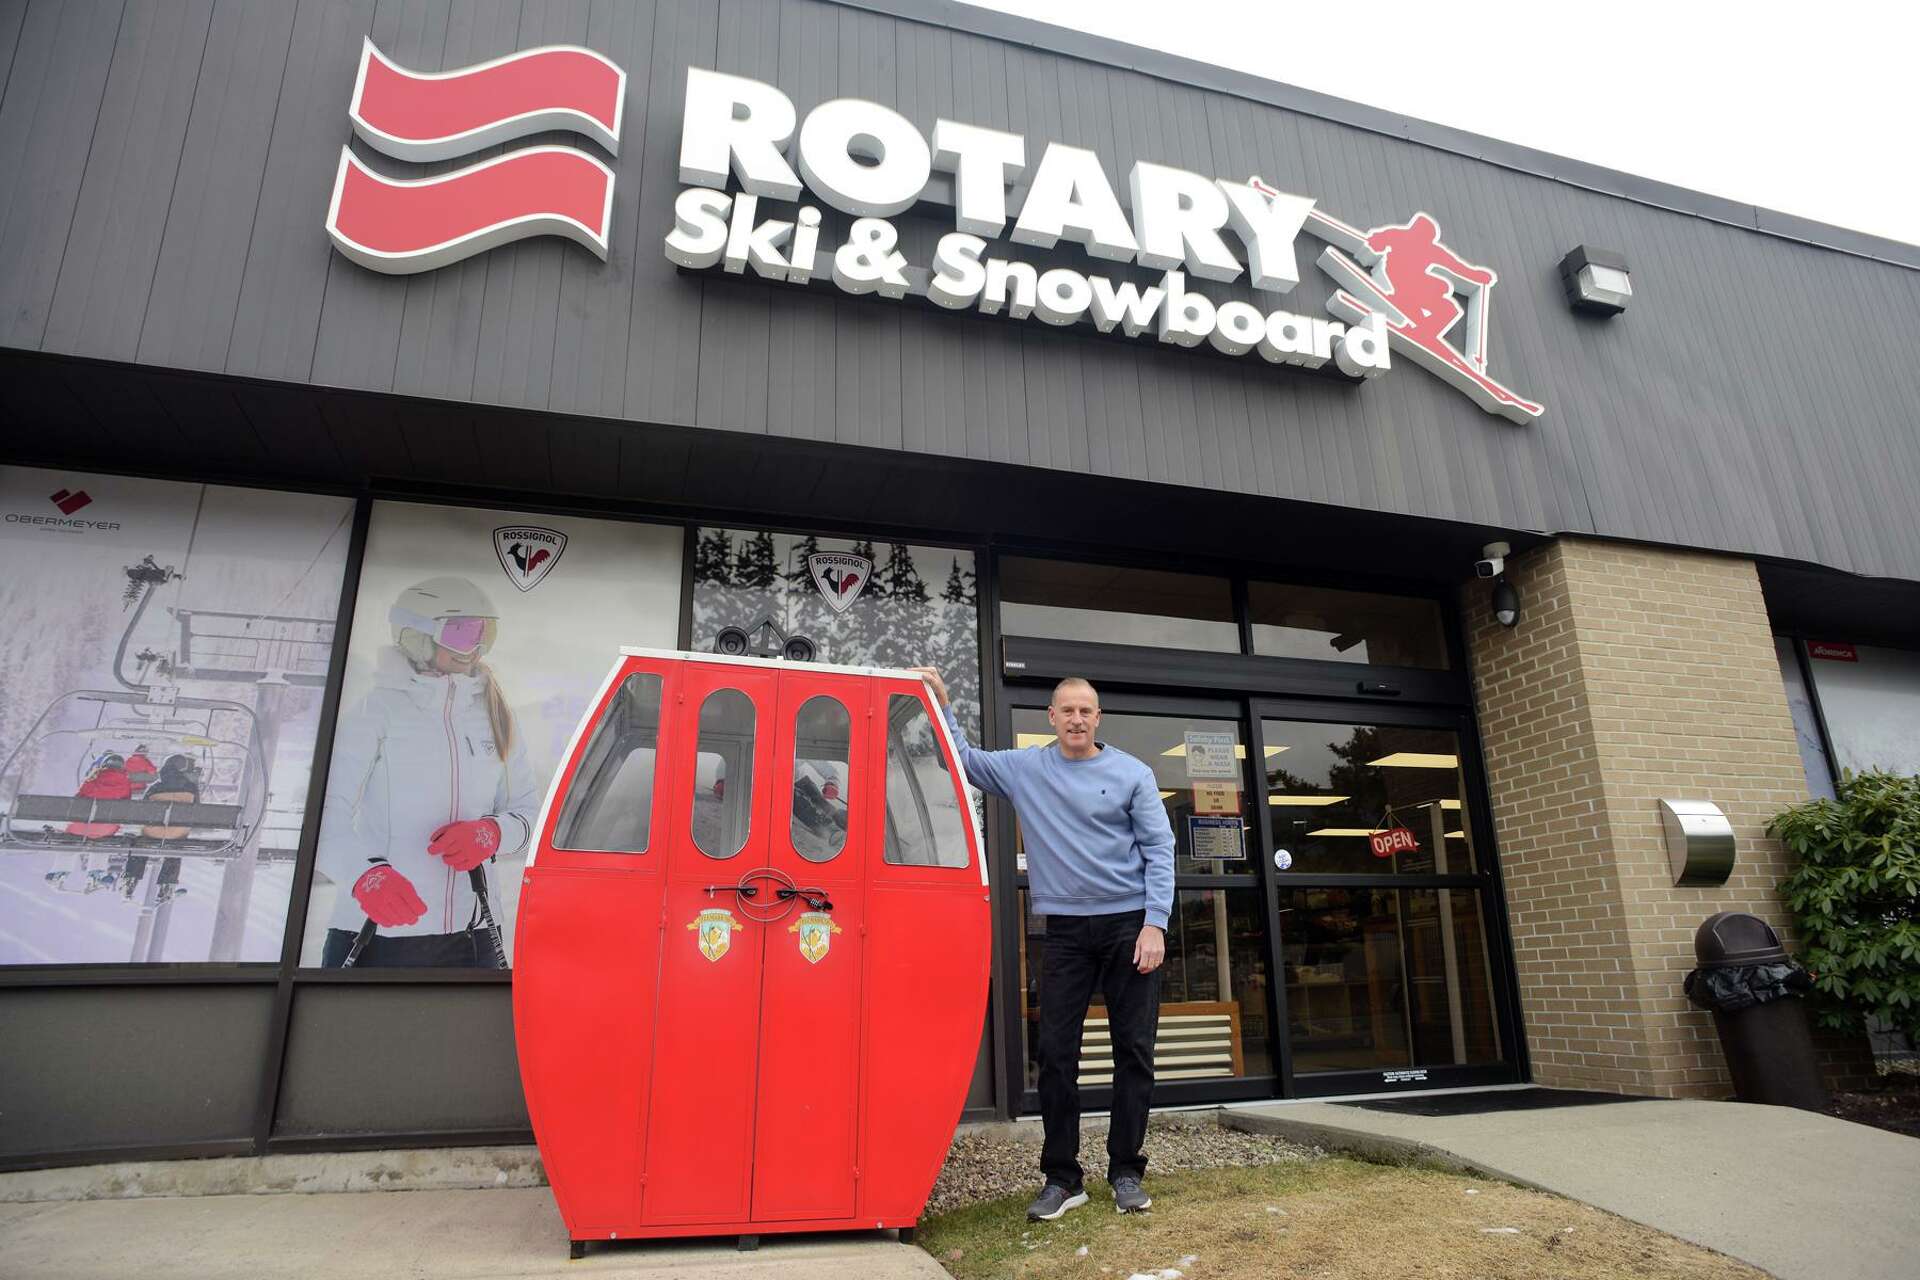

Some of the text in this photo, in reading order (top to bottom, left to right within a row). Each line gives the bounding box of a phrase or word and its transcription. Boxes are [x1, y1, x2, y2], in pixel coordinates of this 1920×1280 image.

[679, 67, 1317, 294] ROTARY
[665, 187, 1392, 379] Ski & Snowboard
[5, 513, 121, 531] OBERMEYER
[503, 531, 557, 545] ROSSIGNOL
[815, 556, 865, 569] ROSSIGNOL
[1373, 831, 1413, 853] OPEN
